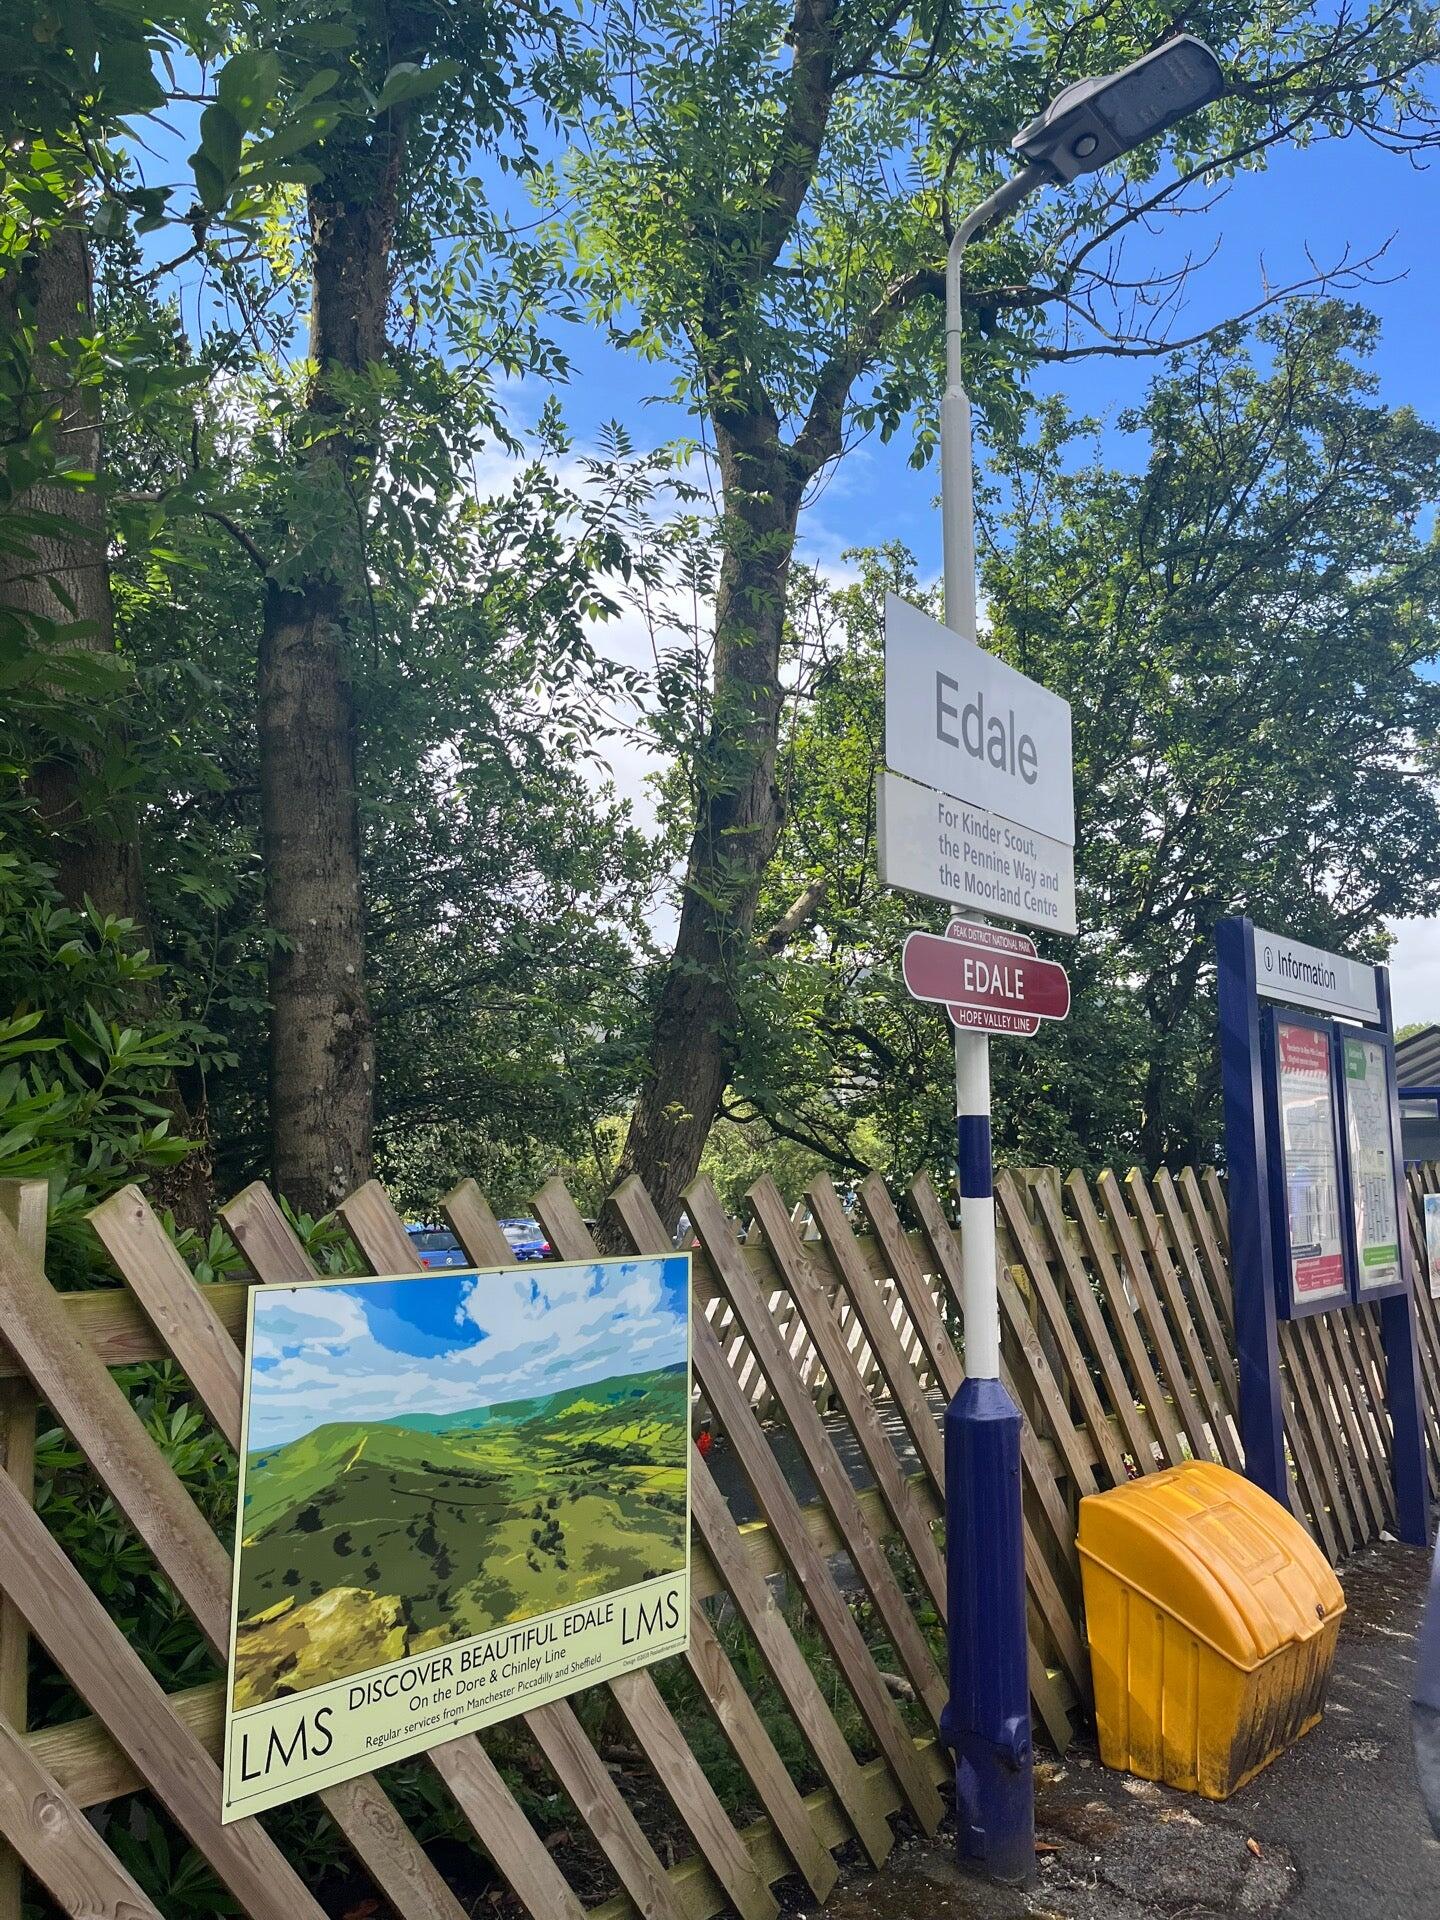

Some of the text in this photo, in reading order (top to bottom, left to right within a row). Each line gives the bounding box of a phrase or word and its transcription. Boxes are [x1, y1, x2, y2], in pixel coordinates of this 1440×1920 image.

[936, 670, 1038, 785] Edale
[938, 802, 1037, 860] For Kinder Scout,
[938, 833, 1059, 892] the Pennine Way and
[939, 864, 1058, 918] the Moorland Centre
[953, 924, 1031, 953] PEAK DISTRICT NATIONAL PARK
[964, 958, 1025, 1000] EDALE
[1277, 949, 1336, 990] Information
[960, 1009, 1030, 1031] HOPE VALLEY LINE
[620, 1590, 680, 1646] LMS
[349, 1602, 614, 1711] DISCOVER BEAUTIFUL EDALE
[409, 1648, 567, 1712] On the Dore & Chinley Line
[365, 1652, 602, 1749] Regular services from Manchester Piccadilly and Sheffield
[241, 1707, 334, 1782] LMS
